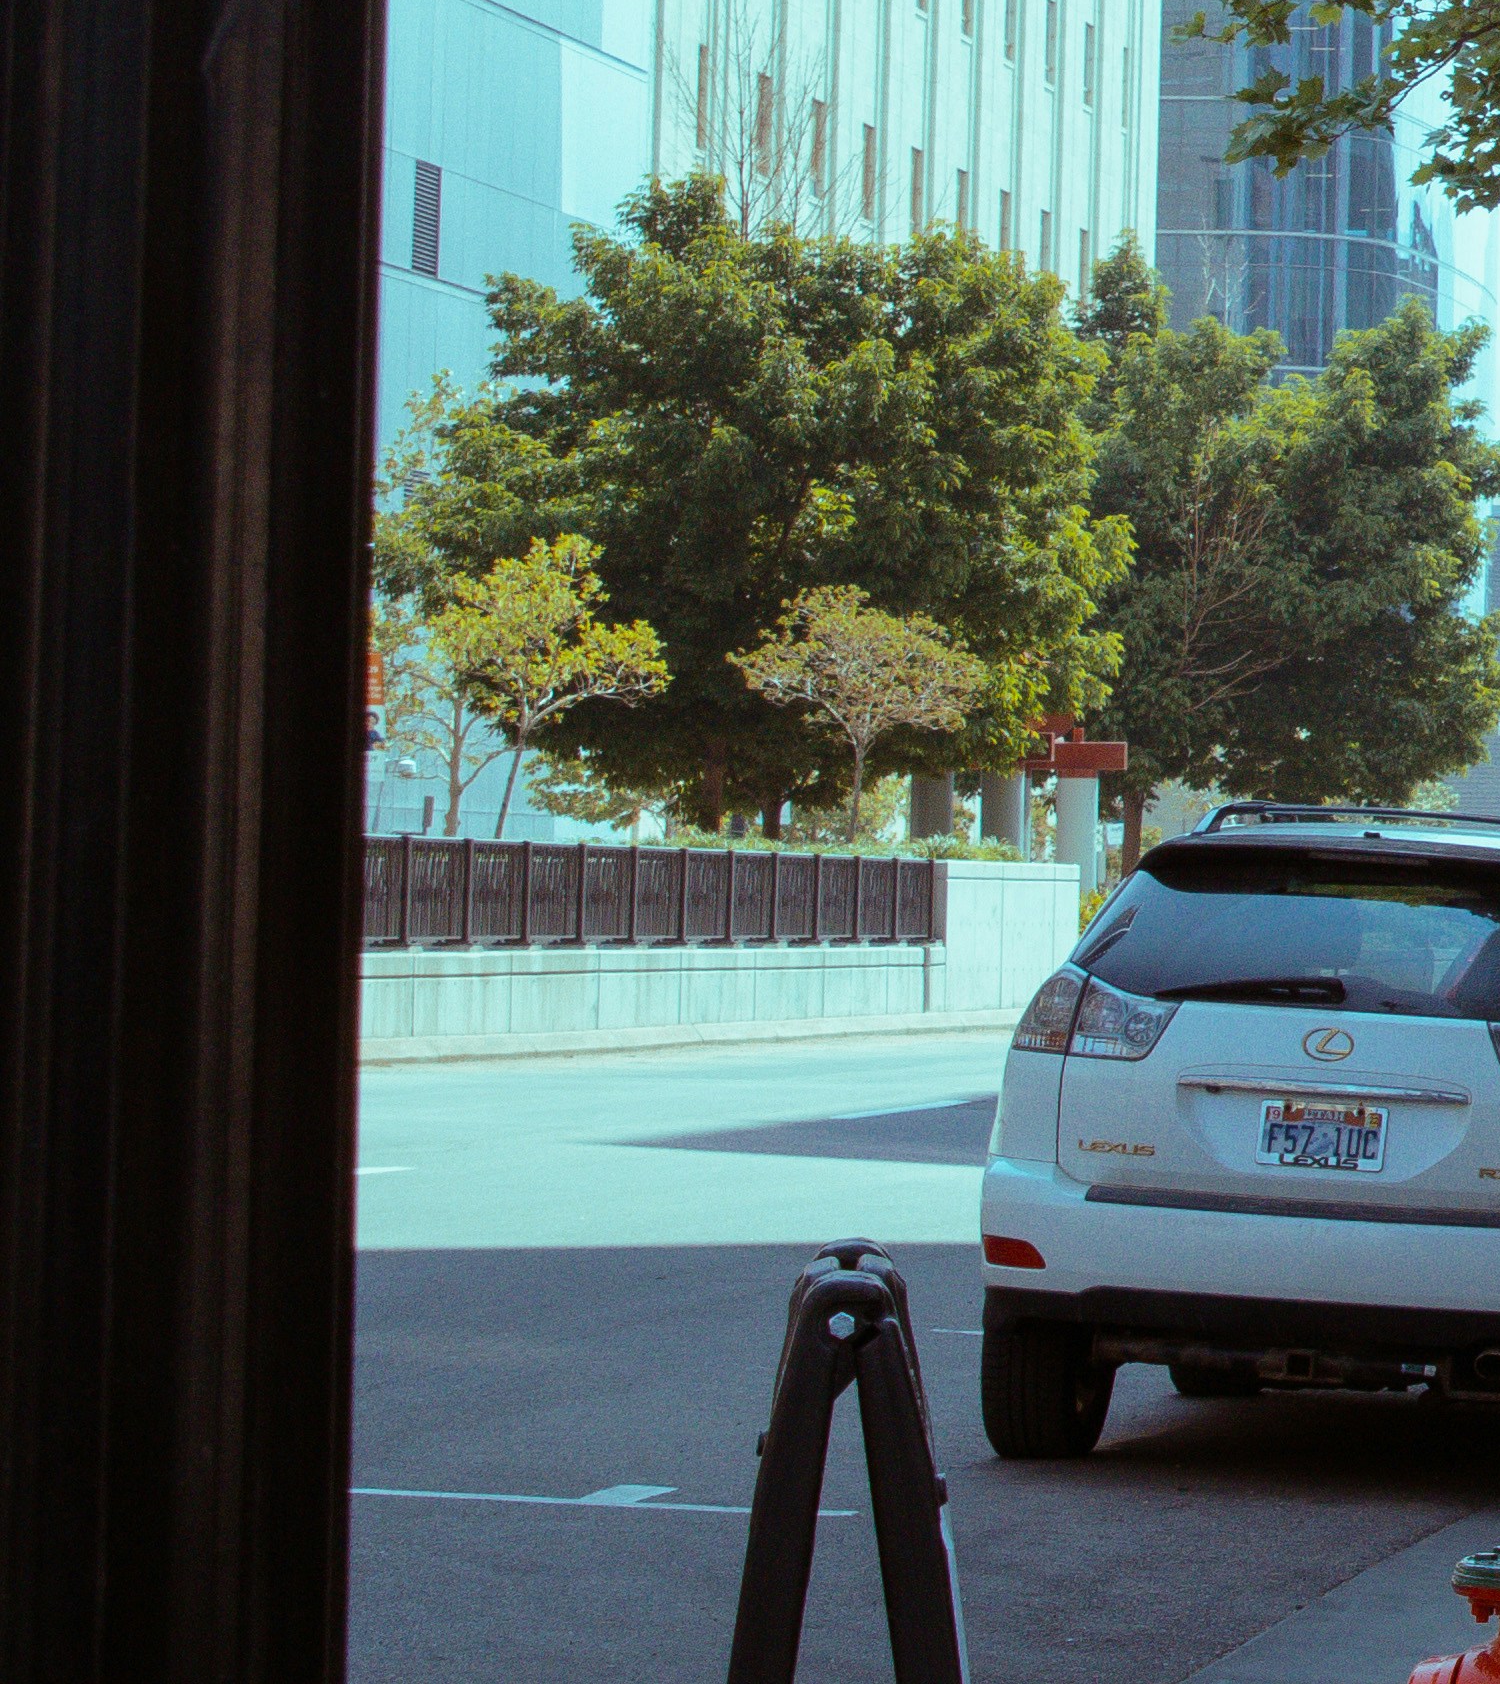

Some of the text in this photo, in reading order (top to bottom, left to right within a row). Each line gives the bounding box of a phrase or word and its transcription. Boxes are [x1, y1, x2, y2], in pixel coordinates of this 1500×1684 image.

[1078, 1138, 1156, 1156] LEXUS
[1267, 1122, 1379, 1160] F57 1UC
[1278, 1153, 1360, 1170] LEXUS
